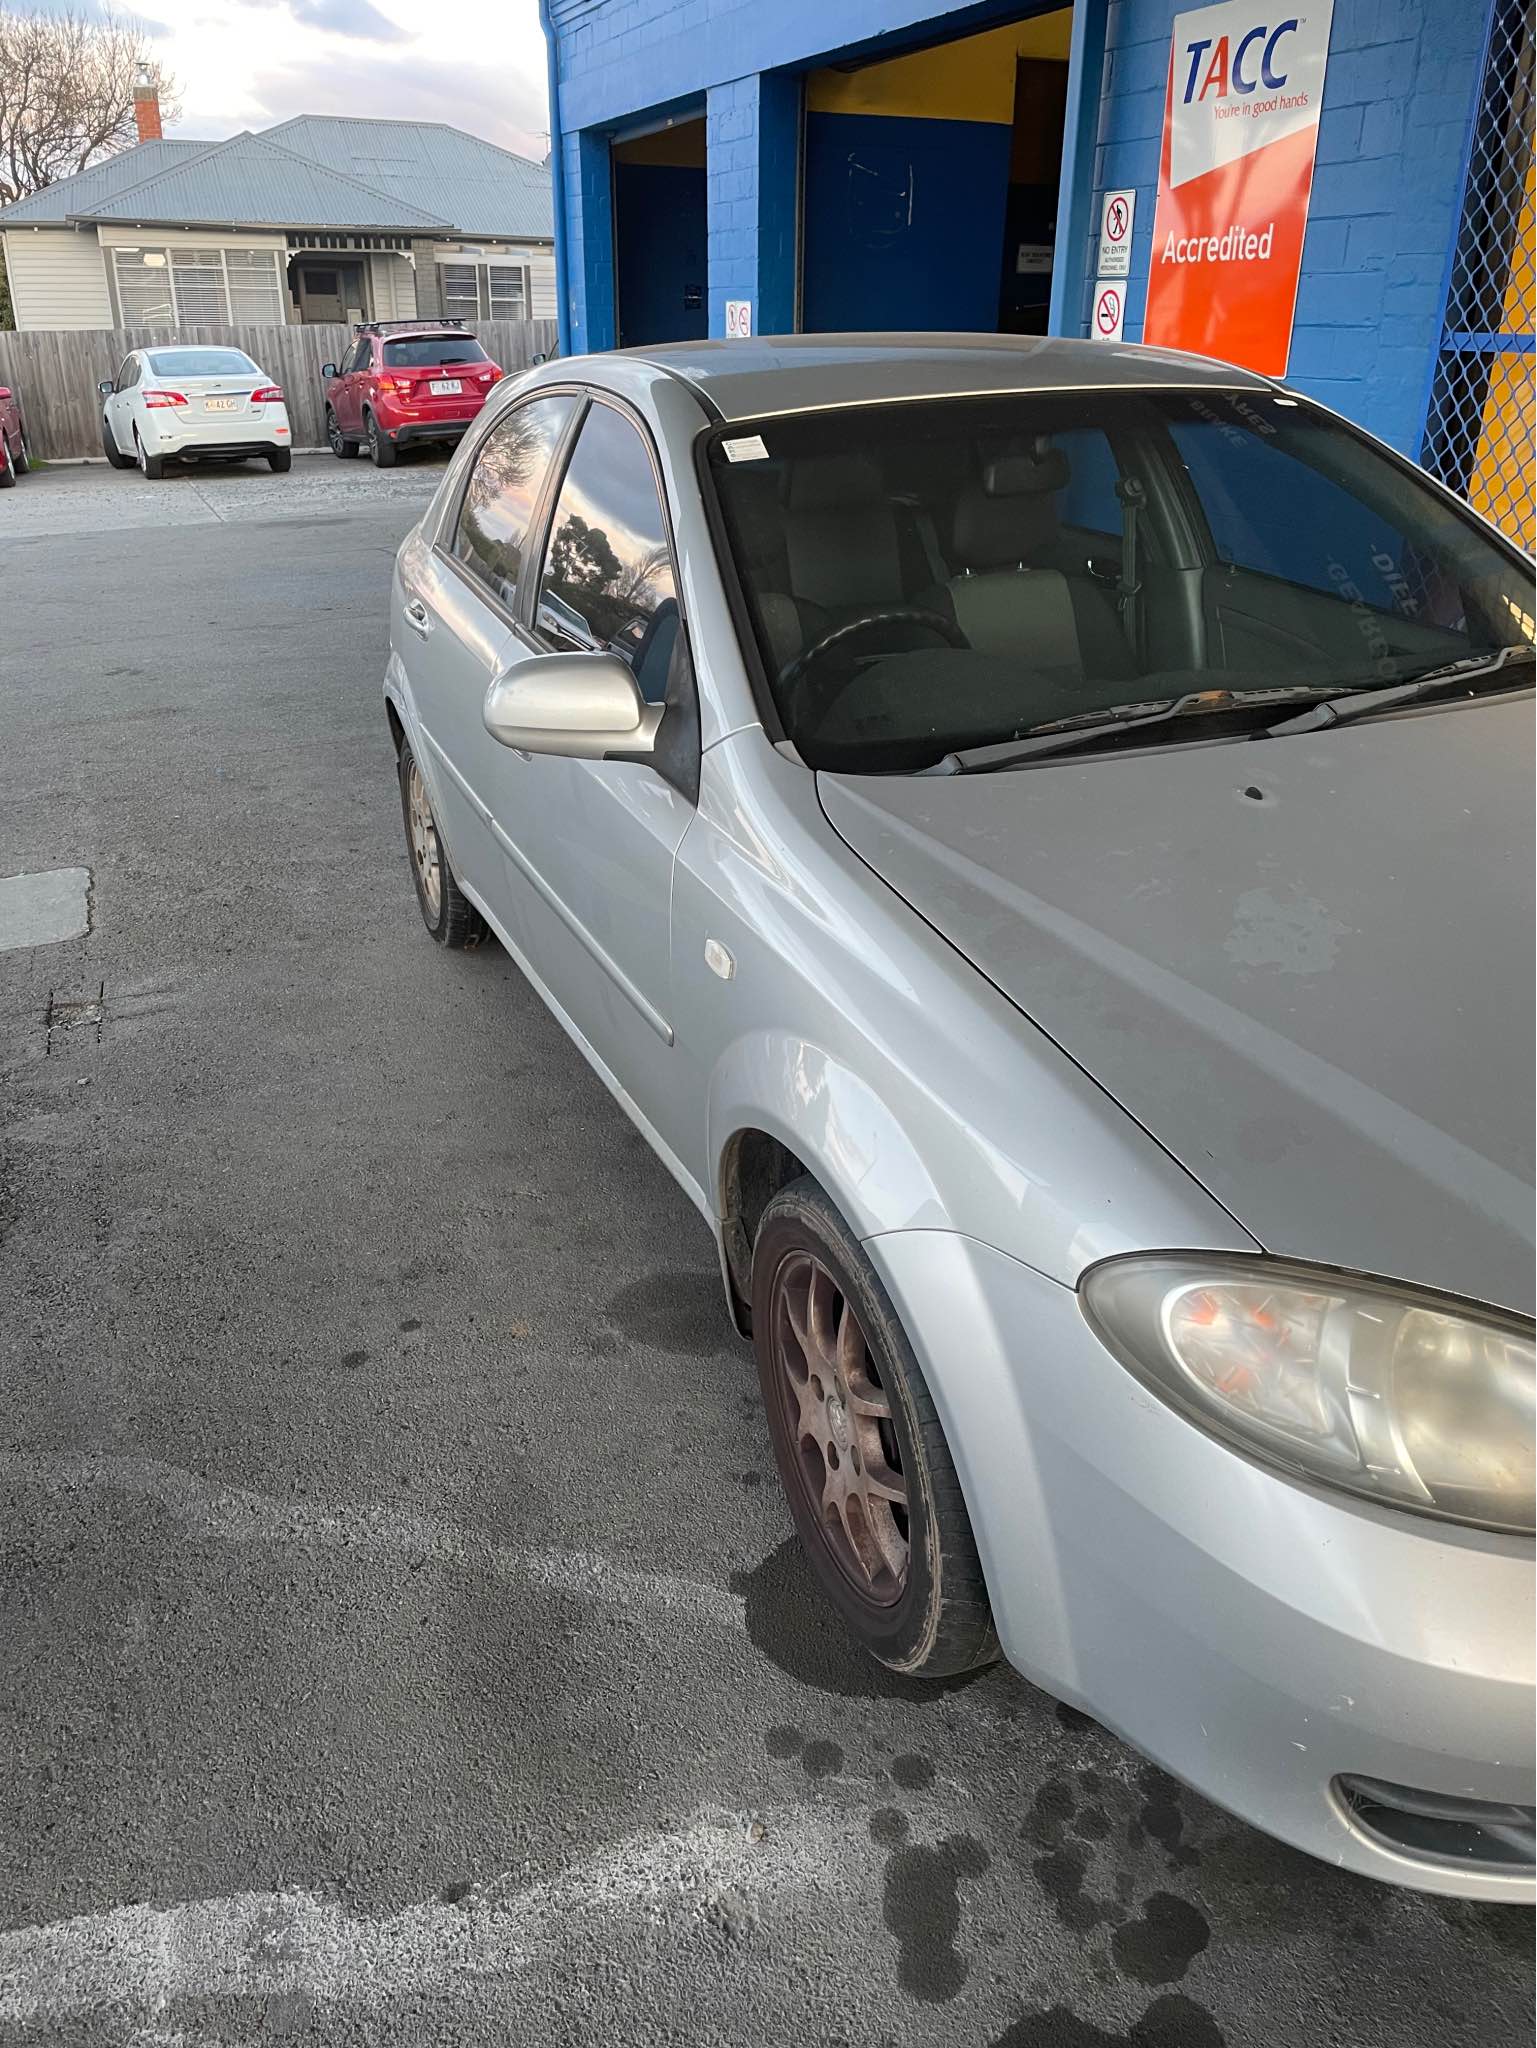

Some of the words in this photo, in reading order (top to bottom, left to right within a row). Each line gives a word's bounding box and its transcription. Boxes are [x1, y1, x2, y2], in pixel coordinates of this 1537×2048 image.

[1183, 19, 1298, 104] TACC
[1242, 102, 1251, 115] in
[1252, 96, 1277, 118] good
[1279, 92, 1309, 110] hands
[1161, 223, 1274, 264] Accredited
